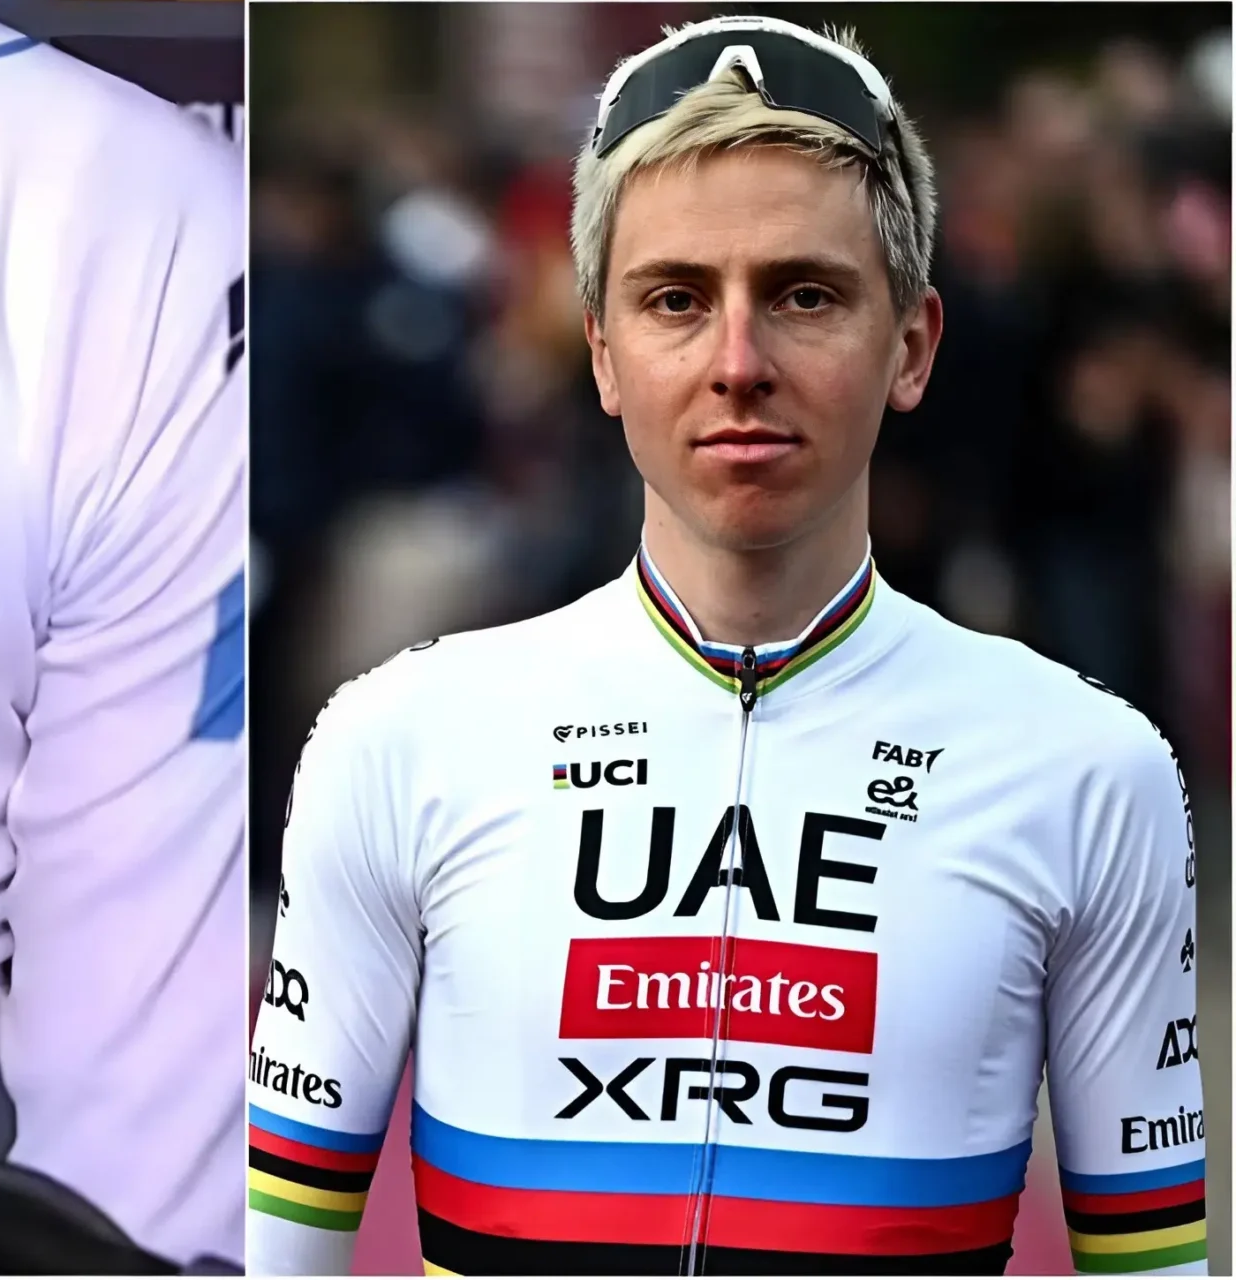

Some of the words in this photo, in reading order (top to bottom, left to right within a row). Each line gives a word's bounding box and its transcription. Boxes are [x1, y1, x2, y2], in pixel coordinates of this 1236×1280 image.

[576, 721, 648, 739] PISSEI
[570, 758, 648, 789] UCI
[573, 804, 887, 933] UAE
[596, 961, 846, 1021] Emirates
[553, 1056, 870, 1134] XRG
